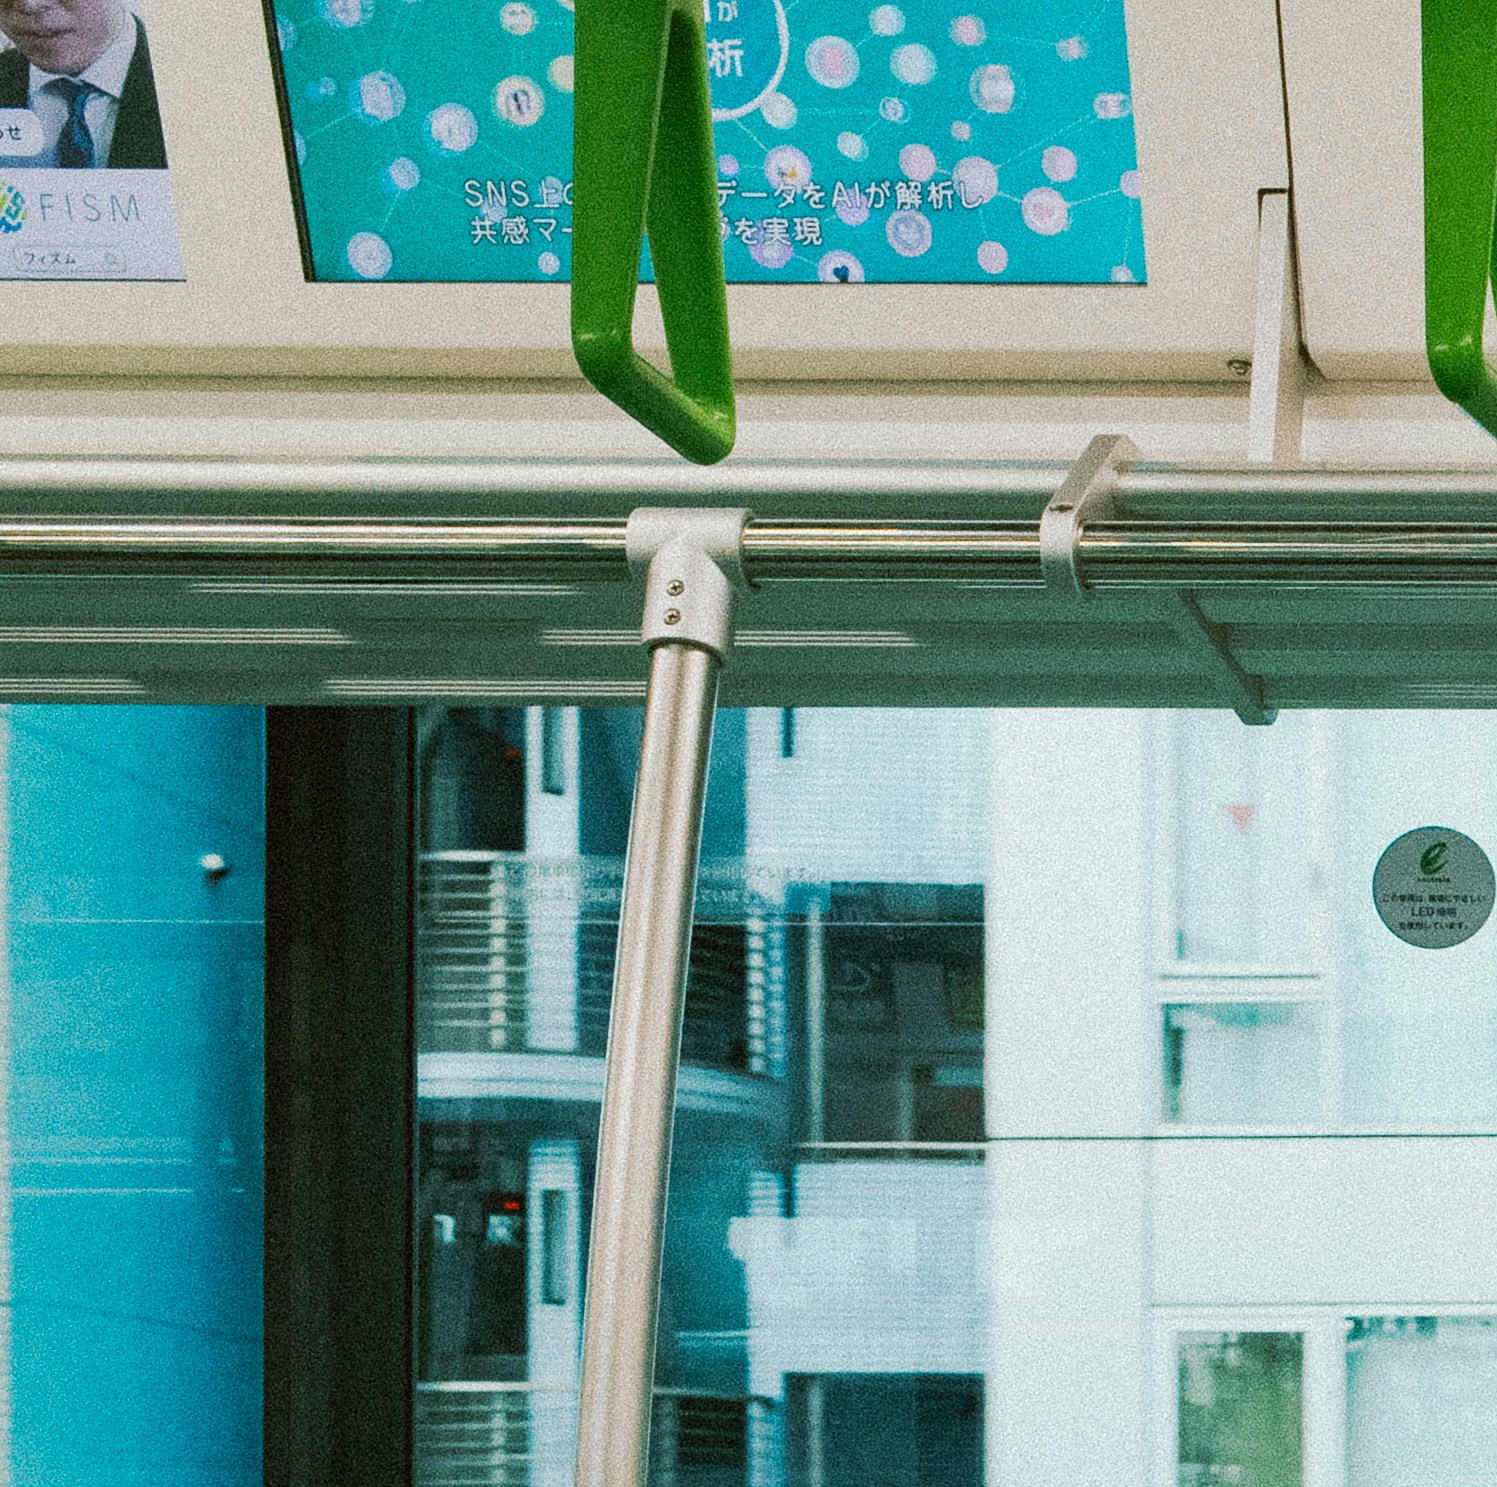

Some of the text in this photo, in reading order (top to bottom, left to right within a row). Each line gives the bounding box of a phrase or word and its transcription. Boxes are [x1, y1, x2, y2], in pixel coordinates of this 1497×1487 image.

[0, 125, 21, 141] せ
[39, 191, 141, 222] FISM
[23, 251, 77, 266] フィズム
